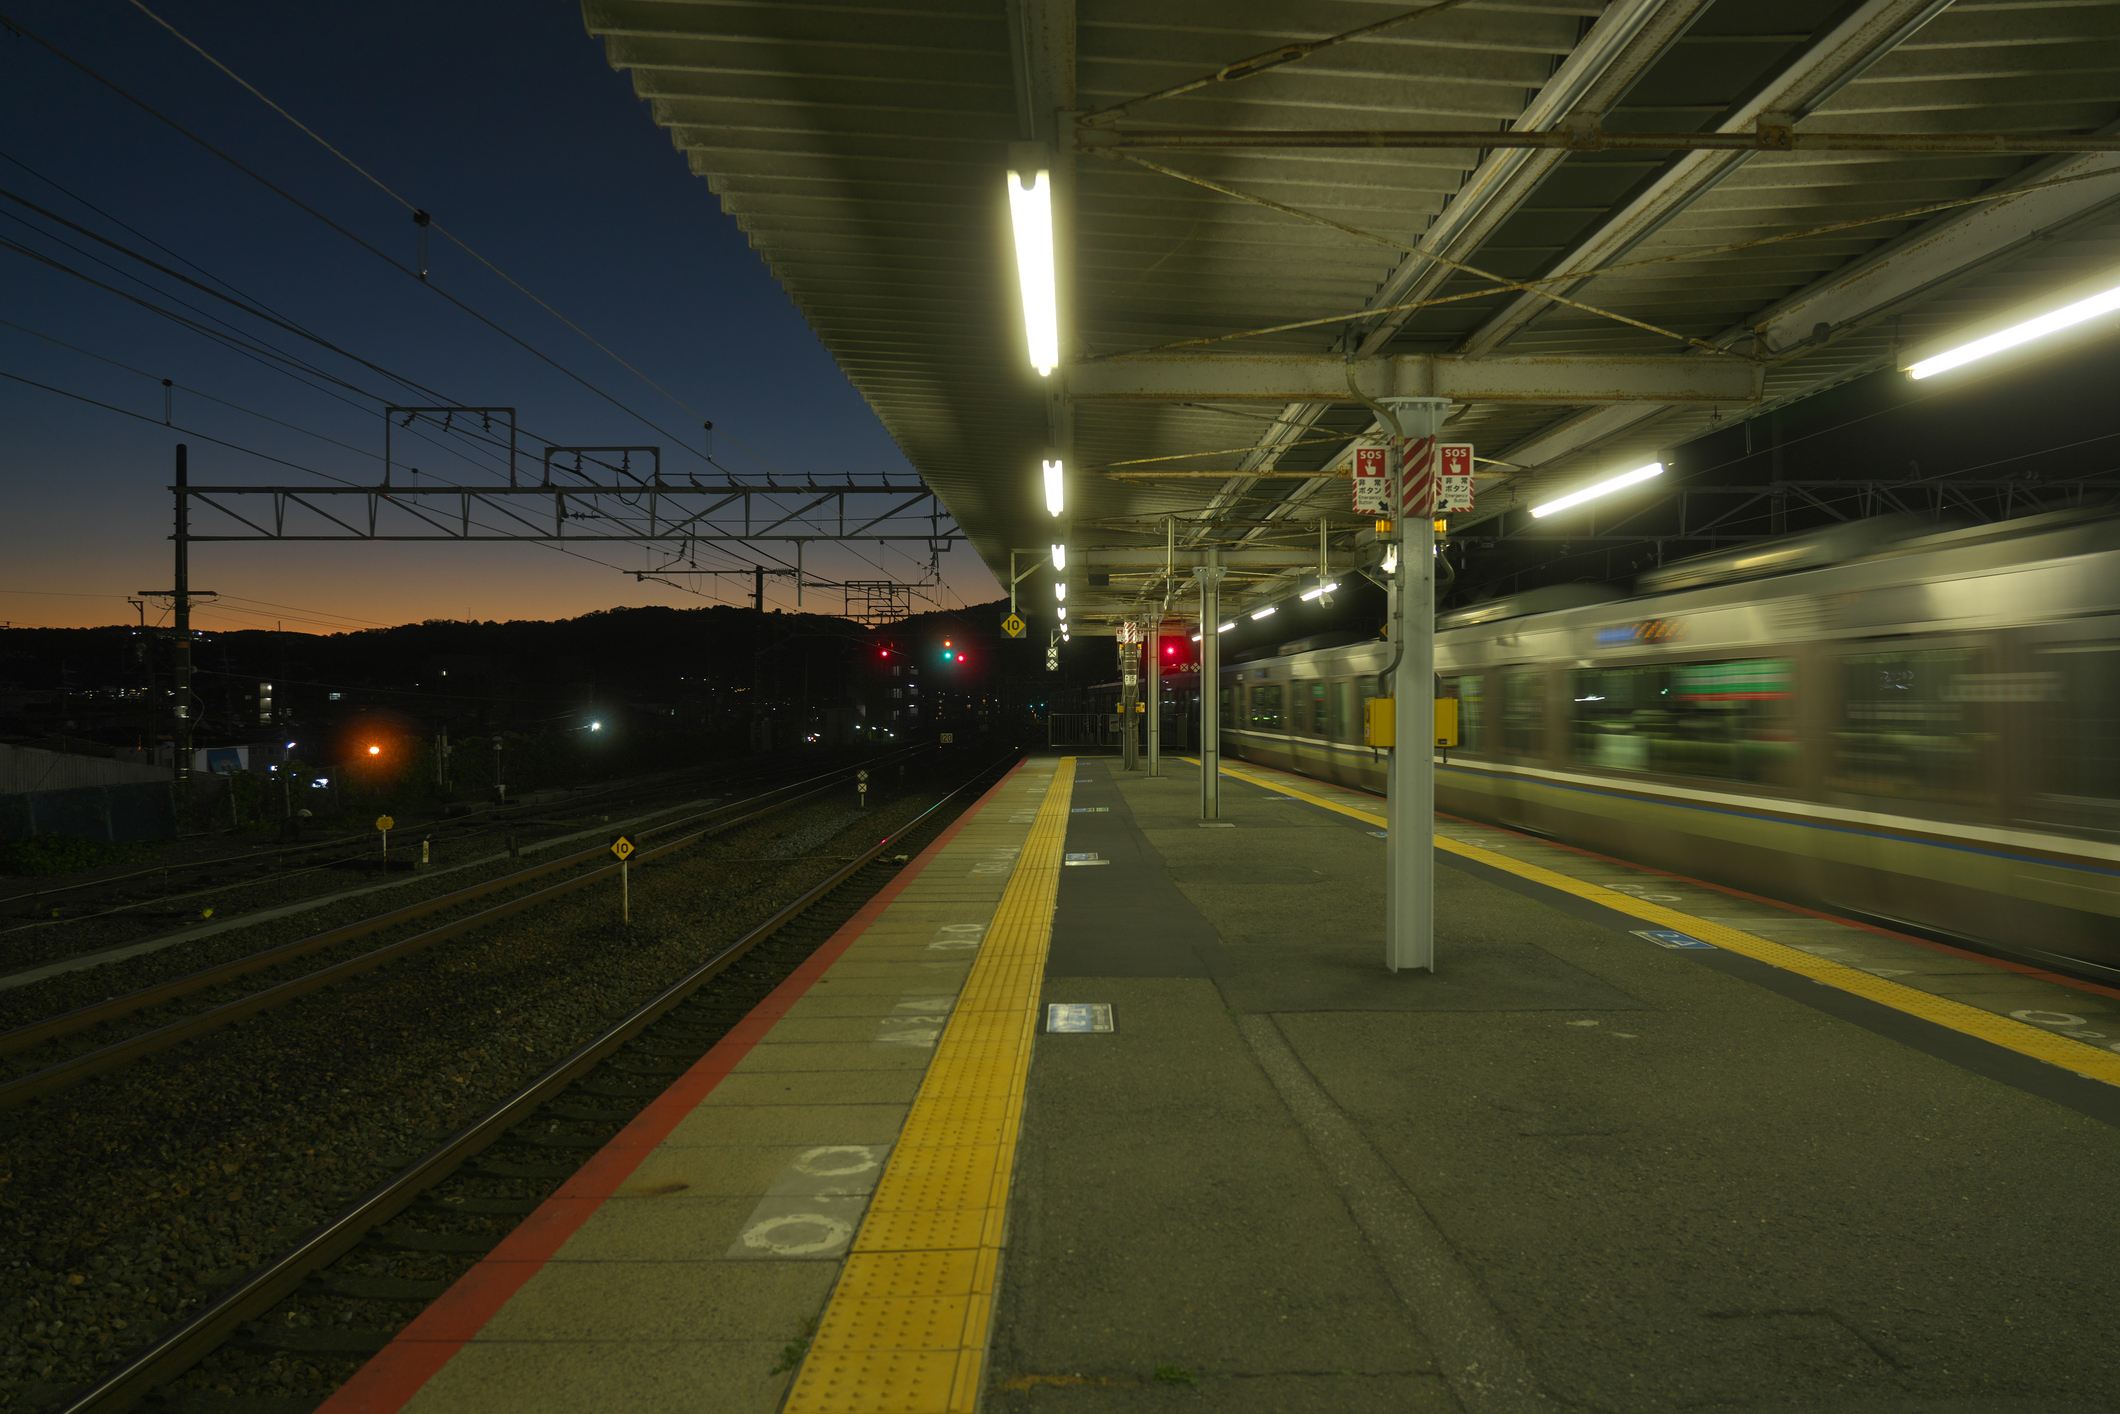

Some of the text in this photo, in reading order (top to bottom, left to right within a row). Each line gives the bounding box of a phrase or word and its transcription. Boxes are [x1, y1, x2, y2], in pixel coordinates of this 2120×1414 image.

[1360, 450, 1382, 459] SOS
[1445, 448, 1467, 457] SOS
[1007, 620, 1020, 630] 10
[616, 843, 629, 854] 10
